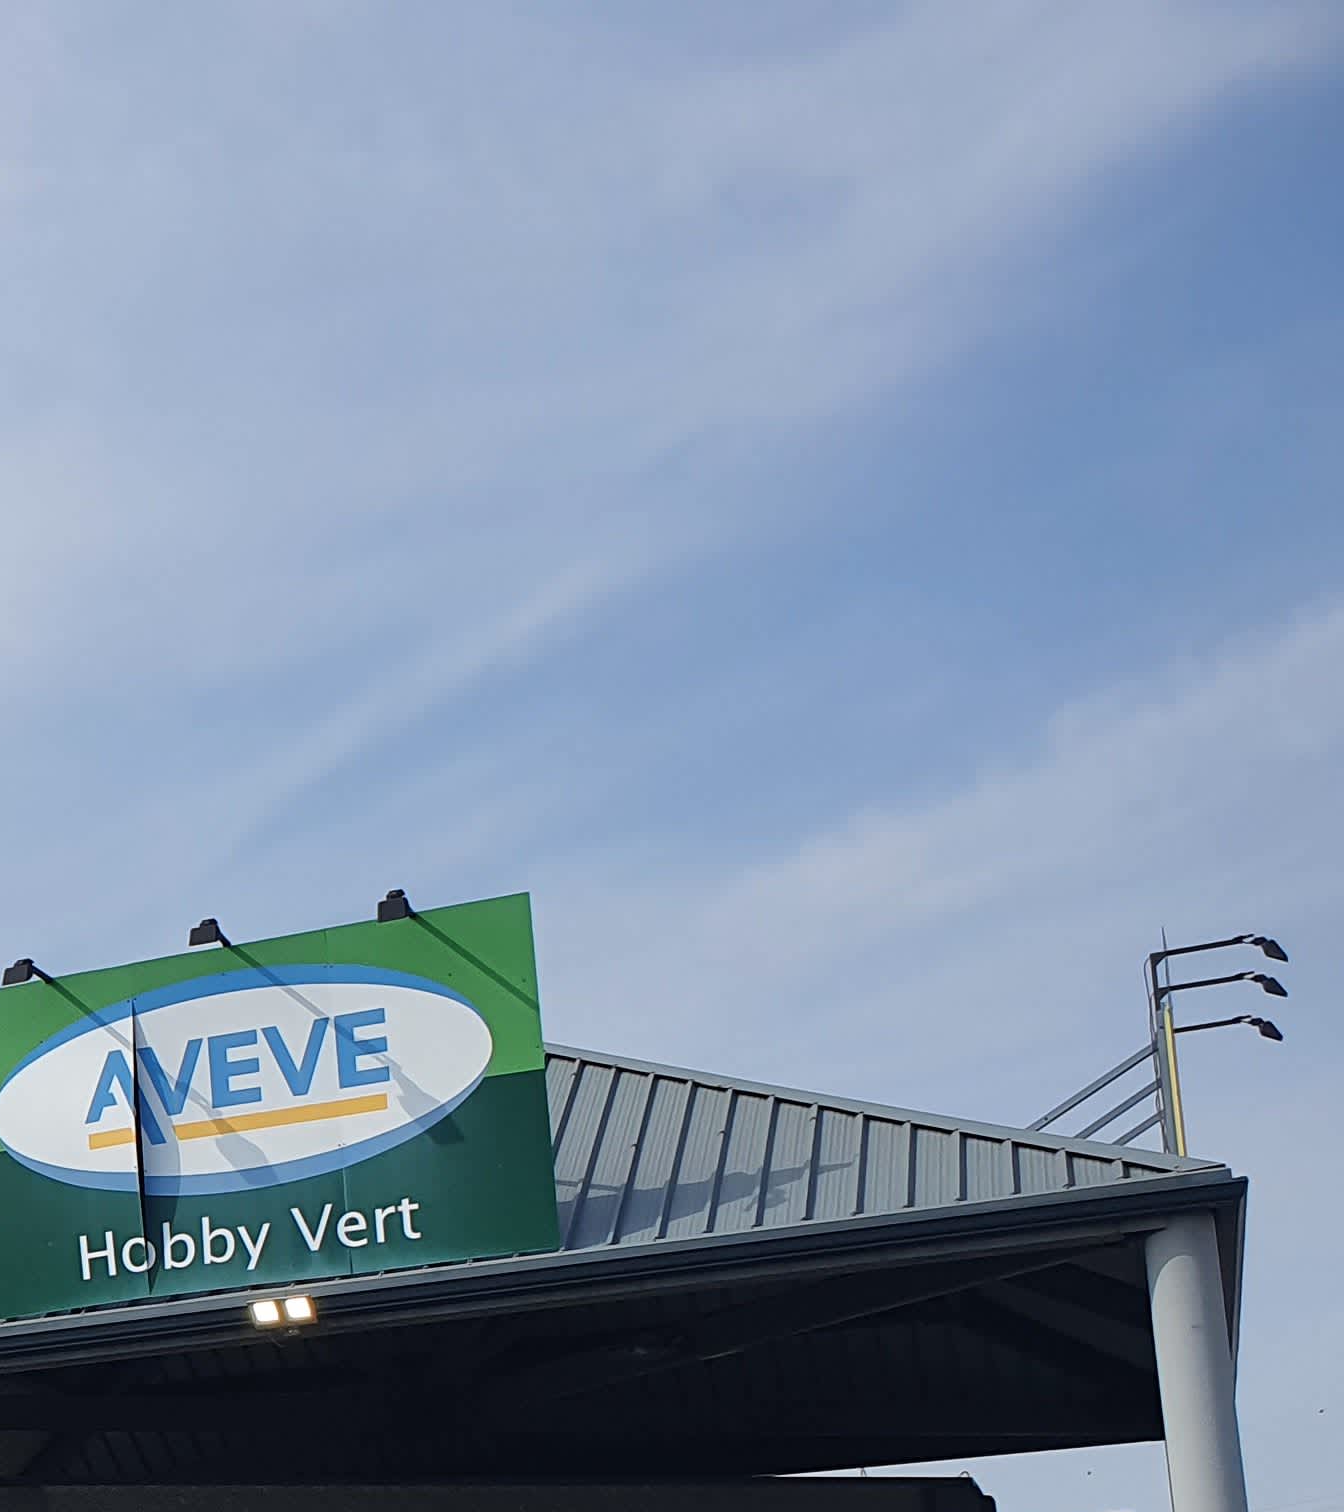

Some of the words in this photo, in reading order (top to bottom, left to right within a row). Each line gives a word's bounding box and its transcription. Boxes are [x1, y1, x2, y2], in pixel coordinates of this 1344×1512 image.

[85, 1007, 391, 1145] AVEVE
[78, 1215, 271, 1282] Hobby
[290, 1195, 423, 1252] Vert
